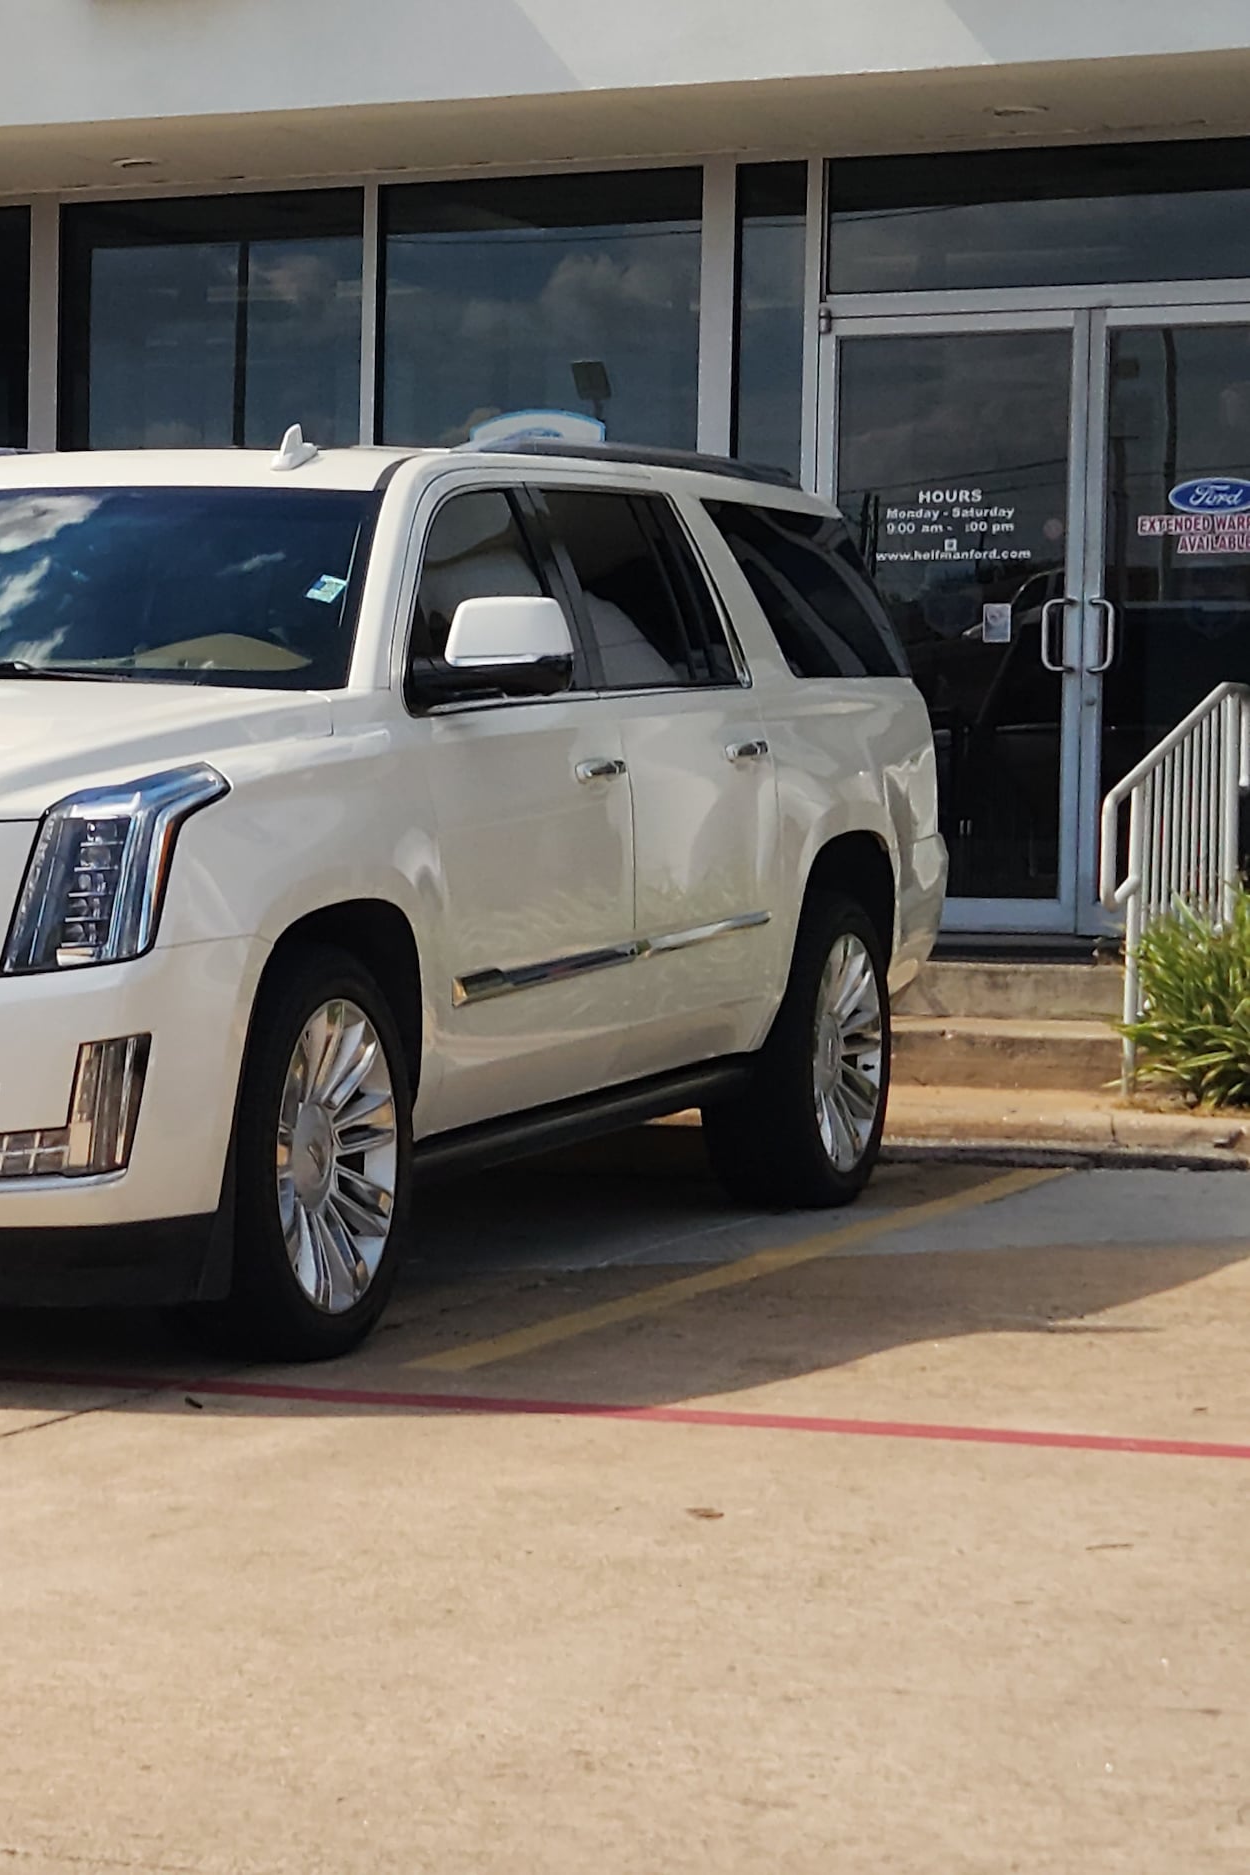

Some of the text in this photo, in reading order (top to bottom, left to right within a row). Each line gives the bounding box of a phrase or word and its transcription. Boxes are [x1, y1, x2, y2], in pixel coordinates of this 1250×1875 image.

[918, 489, 983, 504] HOURS
[1189, 484, 1244, 506] Ford
[886, 507, 940, 521] Monday
[951, 506, 1015, 520] Saturday
[921, 524, 943, 534] am
[992, 522, 1015, 535] pm
[1139, 516, 1212, 533] EXTENDED
[1178, 536, 1250, 552] AVAILABLE
[876, 549, 1032, 562] www.helfmanford.com
